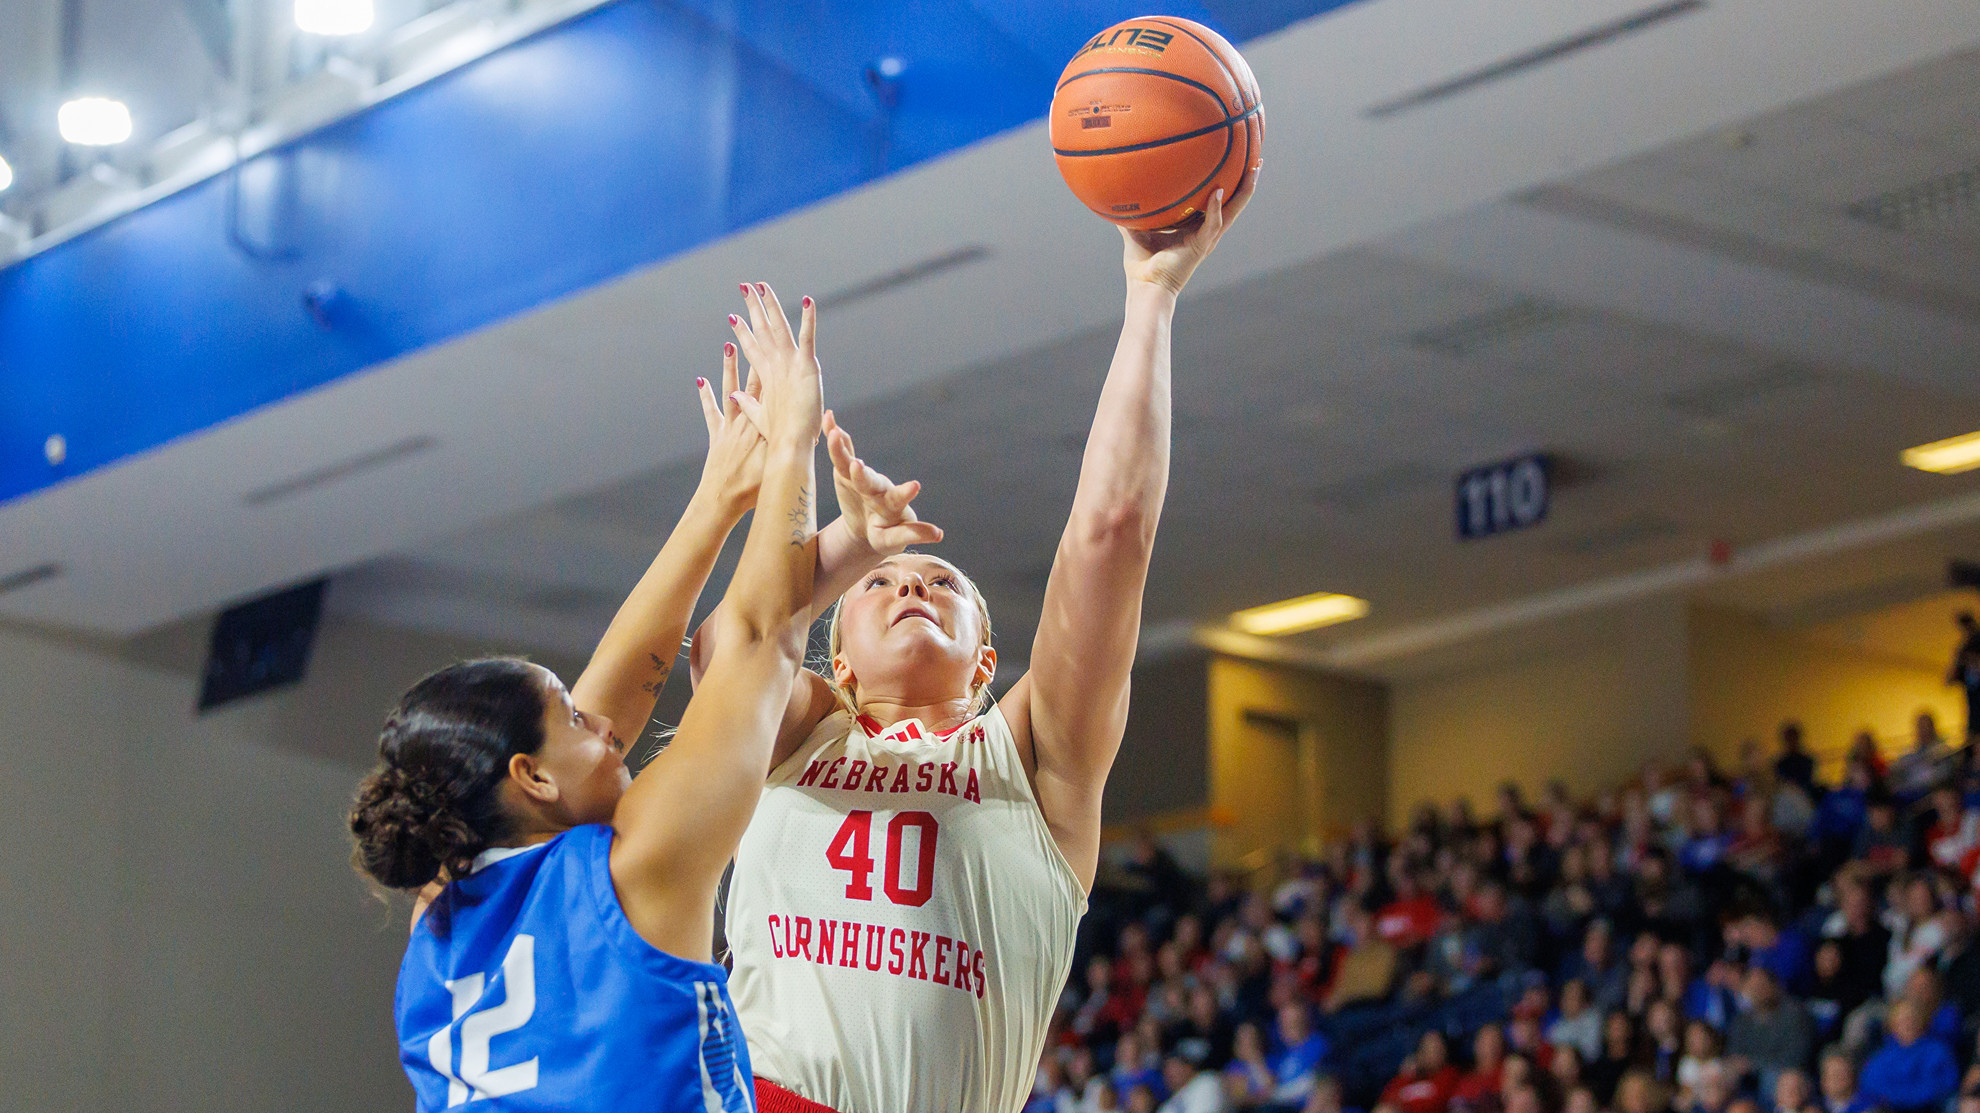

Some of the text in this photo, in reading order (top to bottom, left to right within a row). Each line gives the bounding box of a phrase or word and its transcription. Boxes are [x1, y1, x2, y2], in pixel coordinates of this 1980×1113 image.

[1464, 460, 1546, 529] 110
[796, 756, 982, 804] NEBRASKA
[825, 809, 940, 908] 40
[428, 933, 540, 1109] 12
